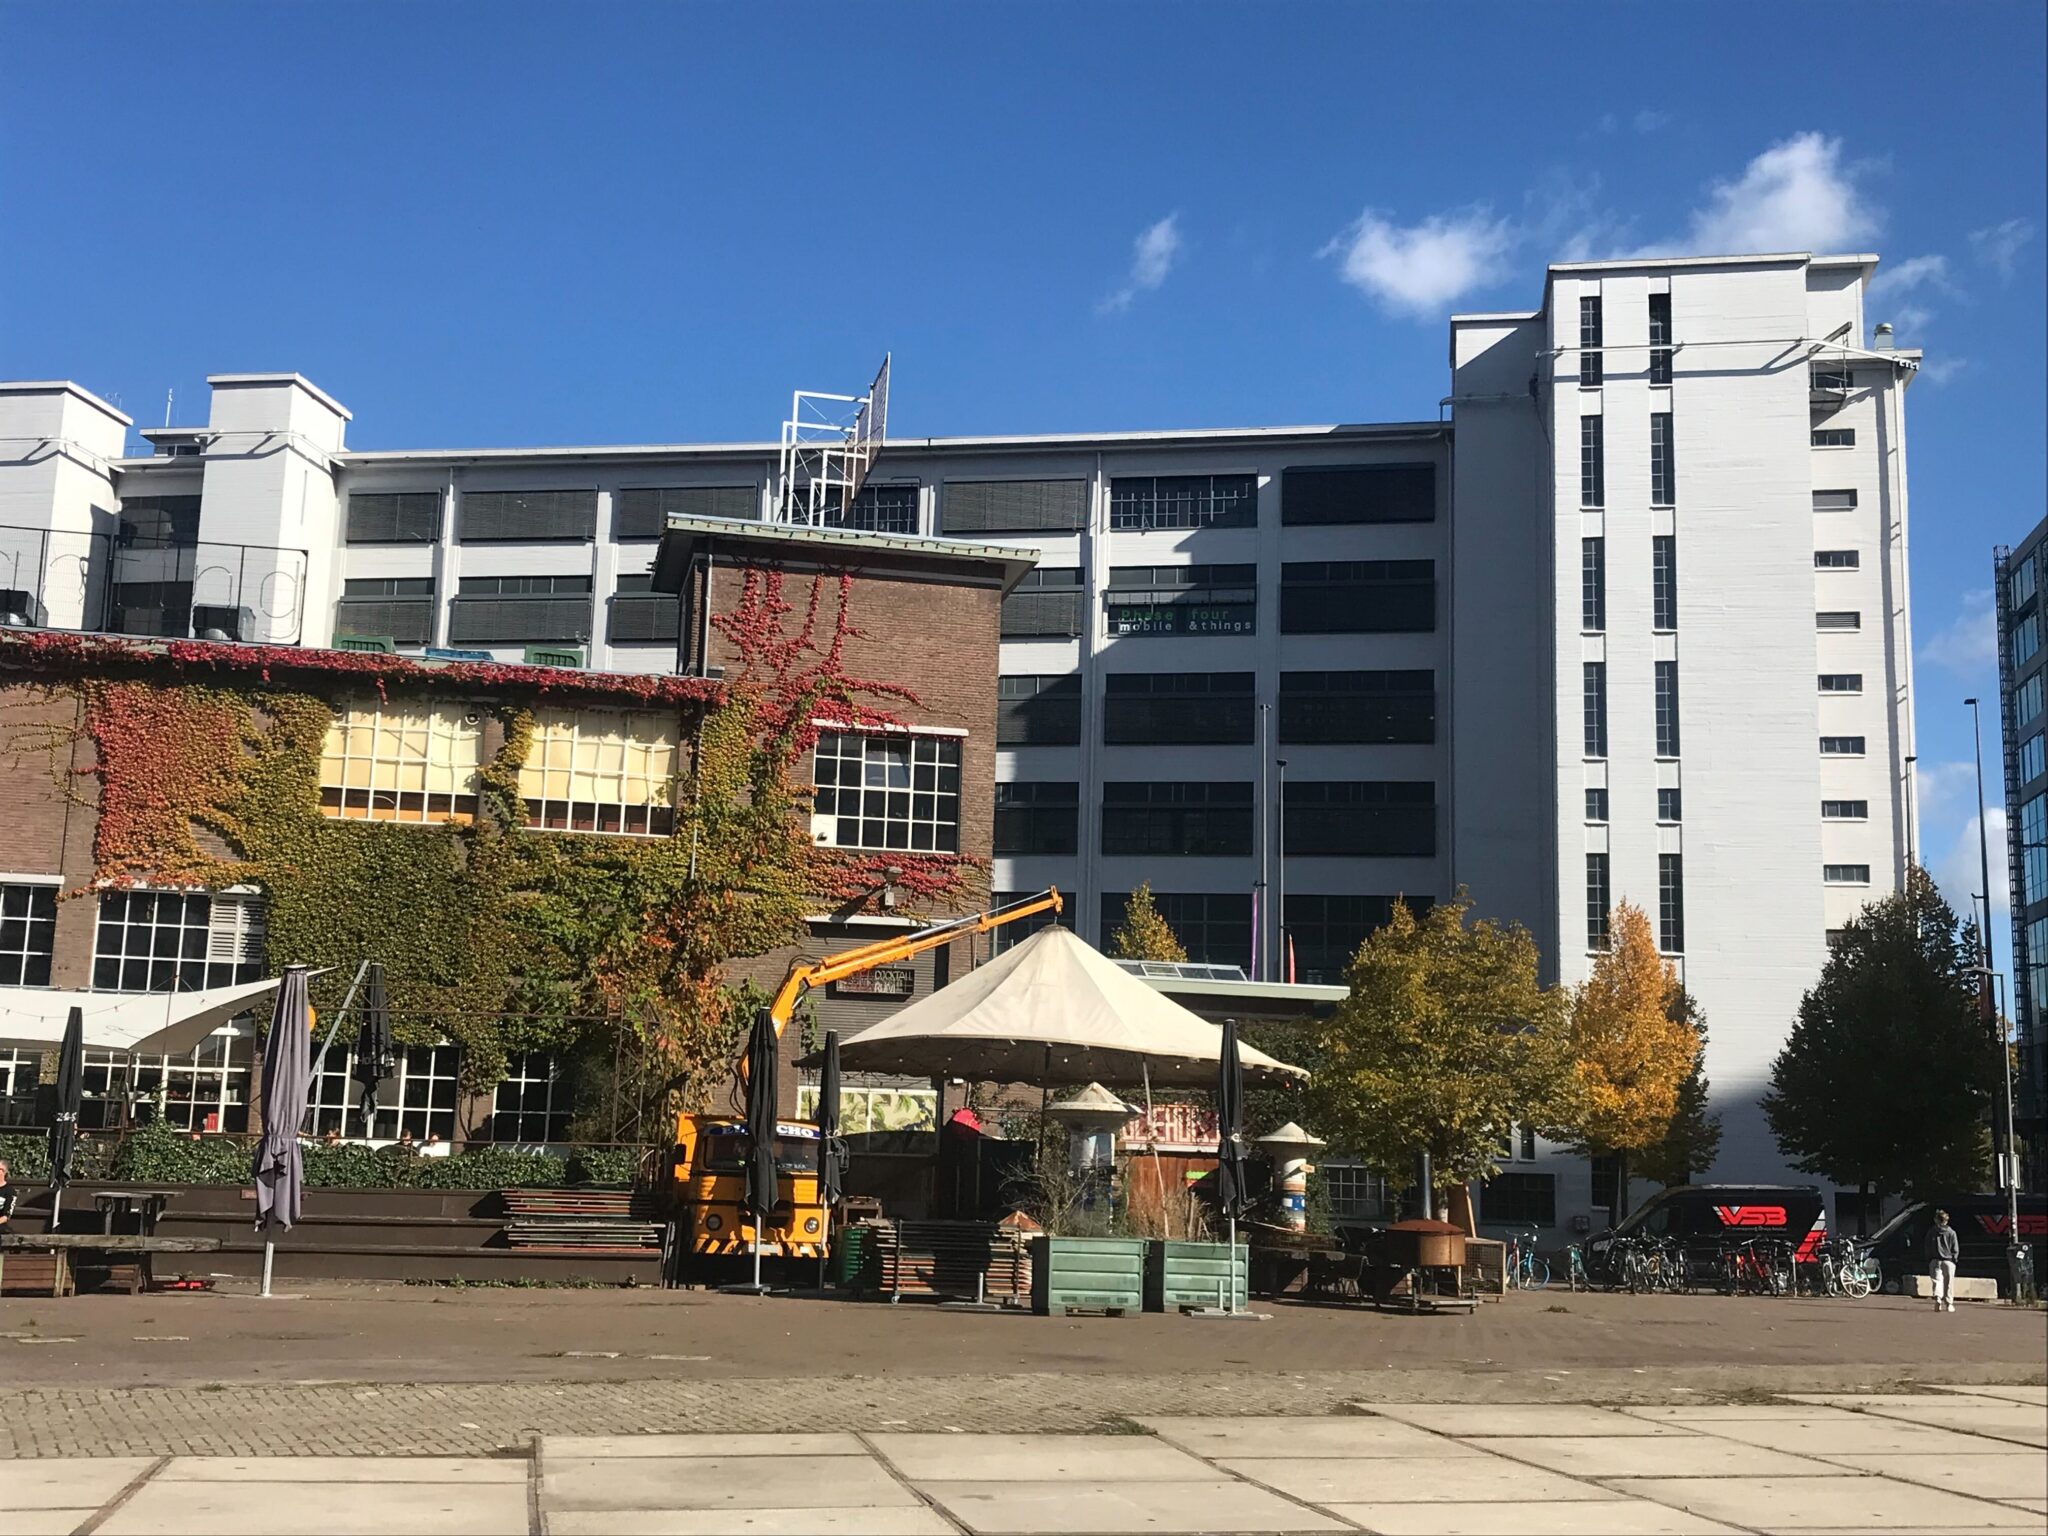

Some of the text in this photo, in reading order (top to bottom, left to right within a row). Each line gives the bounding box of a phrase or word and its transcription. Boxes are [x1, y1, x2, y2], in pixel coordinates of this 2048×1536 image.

[1121, 609, 1229, 620] Phase four
[1119, 620, 1251, 632] mobile &things
[1716, 1206, 1788, 1226] VSB
